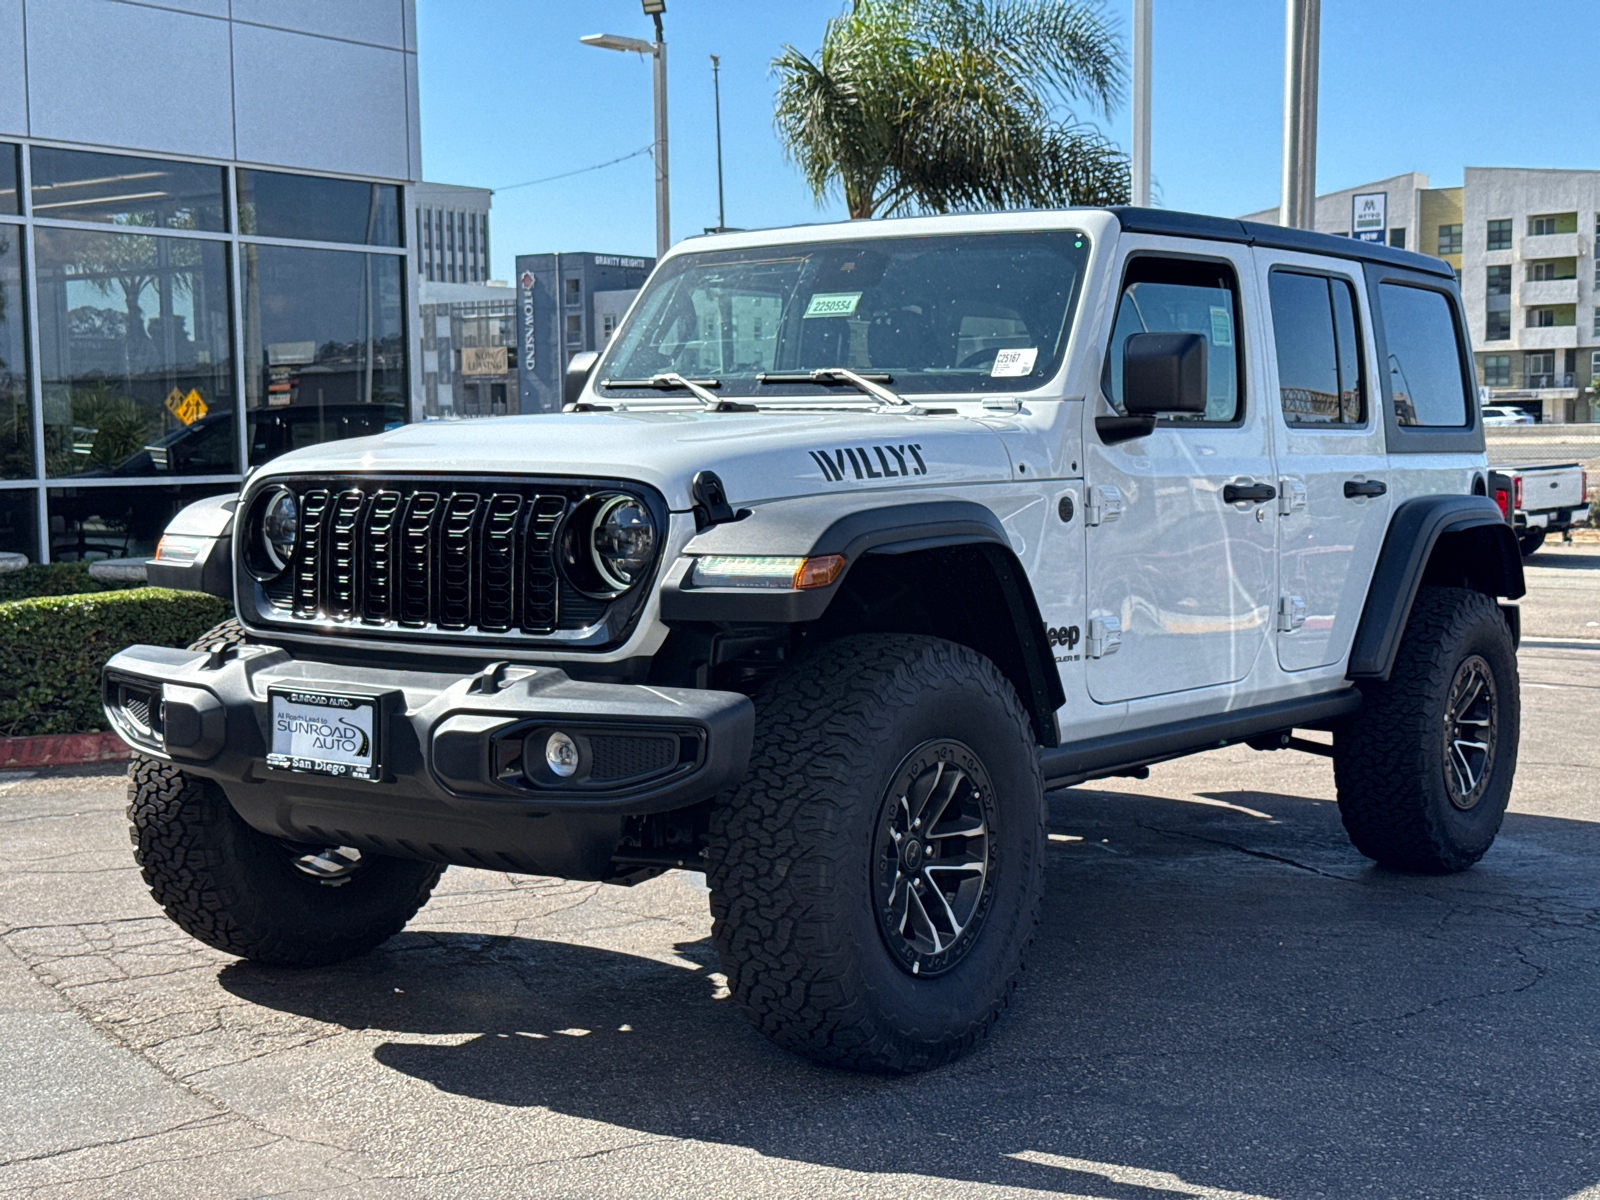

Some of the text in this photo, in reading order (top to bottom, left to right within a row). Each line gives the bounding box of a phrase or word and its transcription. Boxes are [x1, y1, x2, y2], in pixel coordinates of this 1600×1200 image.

[595, 255, 645, 268] GRAVITY HEIGHTS
[812, 300, 852, 312] 2250554
[524, 297, 536, 371] TOWNSEND
[475, 350, 495, 360] NOW
[997, 353, 1021, 363] C25167
[468, 361, 503, 371] LEASING
[808, 444, 927, 482] WILLYS
[291, 693, 350, 707] SUNROAD AUTO
[286, 713, 304, 721] Roads
[305, 715, 320, 724] Lead
[321, 717, 328, 725] to
[277, 720, 356, 739] SUNROAD
[312, 737, 356, 752] AUTO
[292, 758, 312, 769] San
[315, 760, 346, 775] Diego
